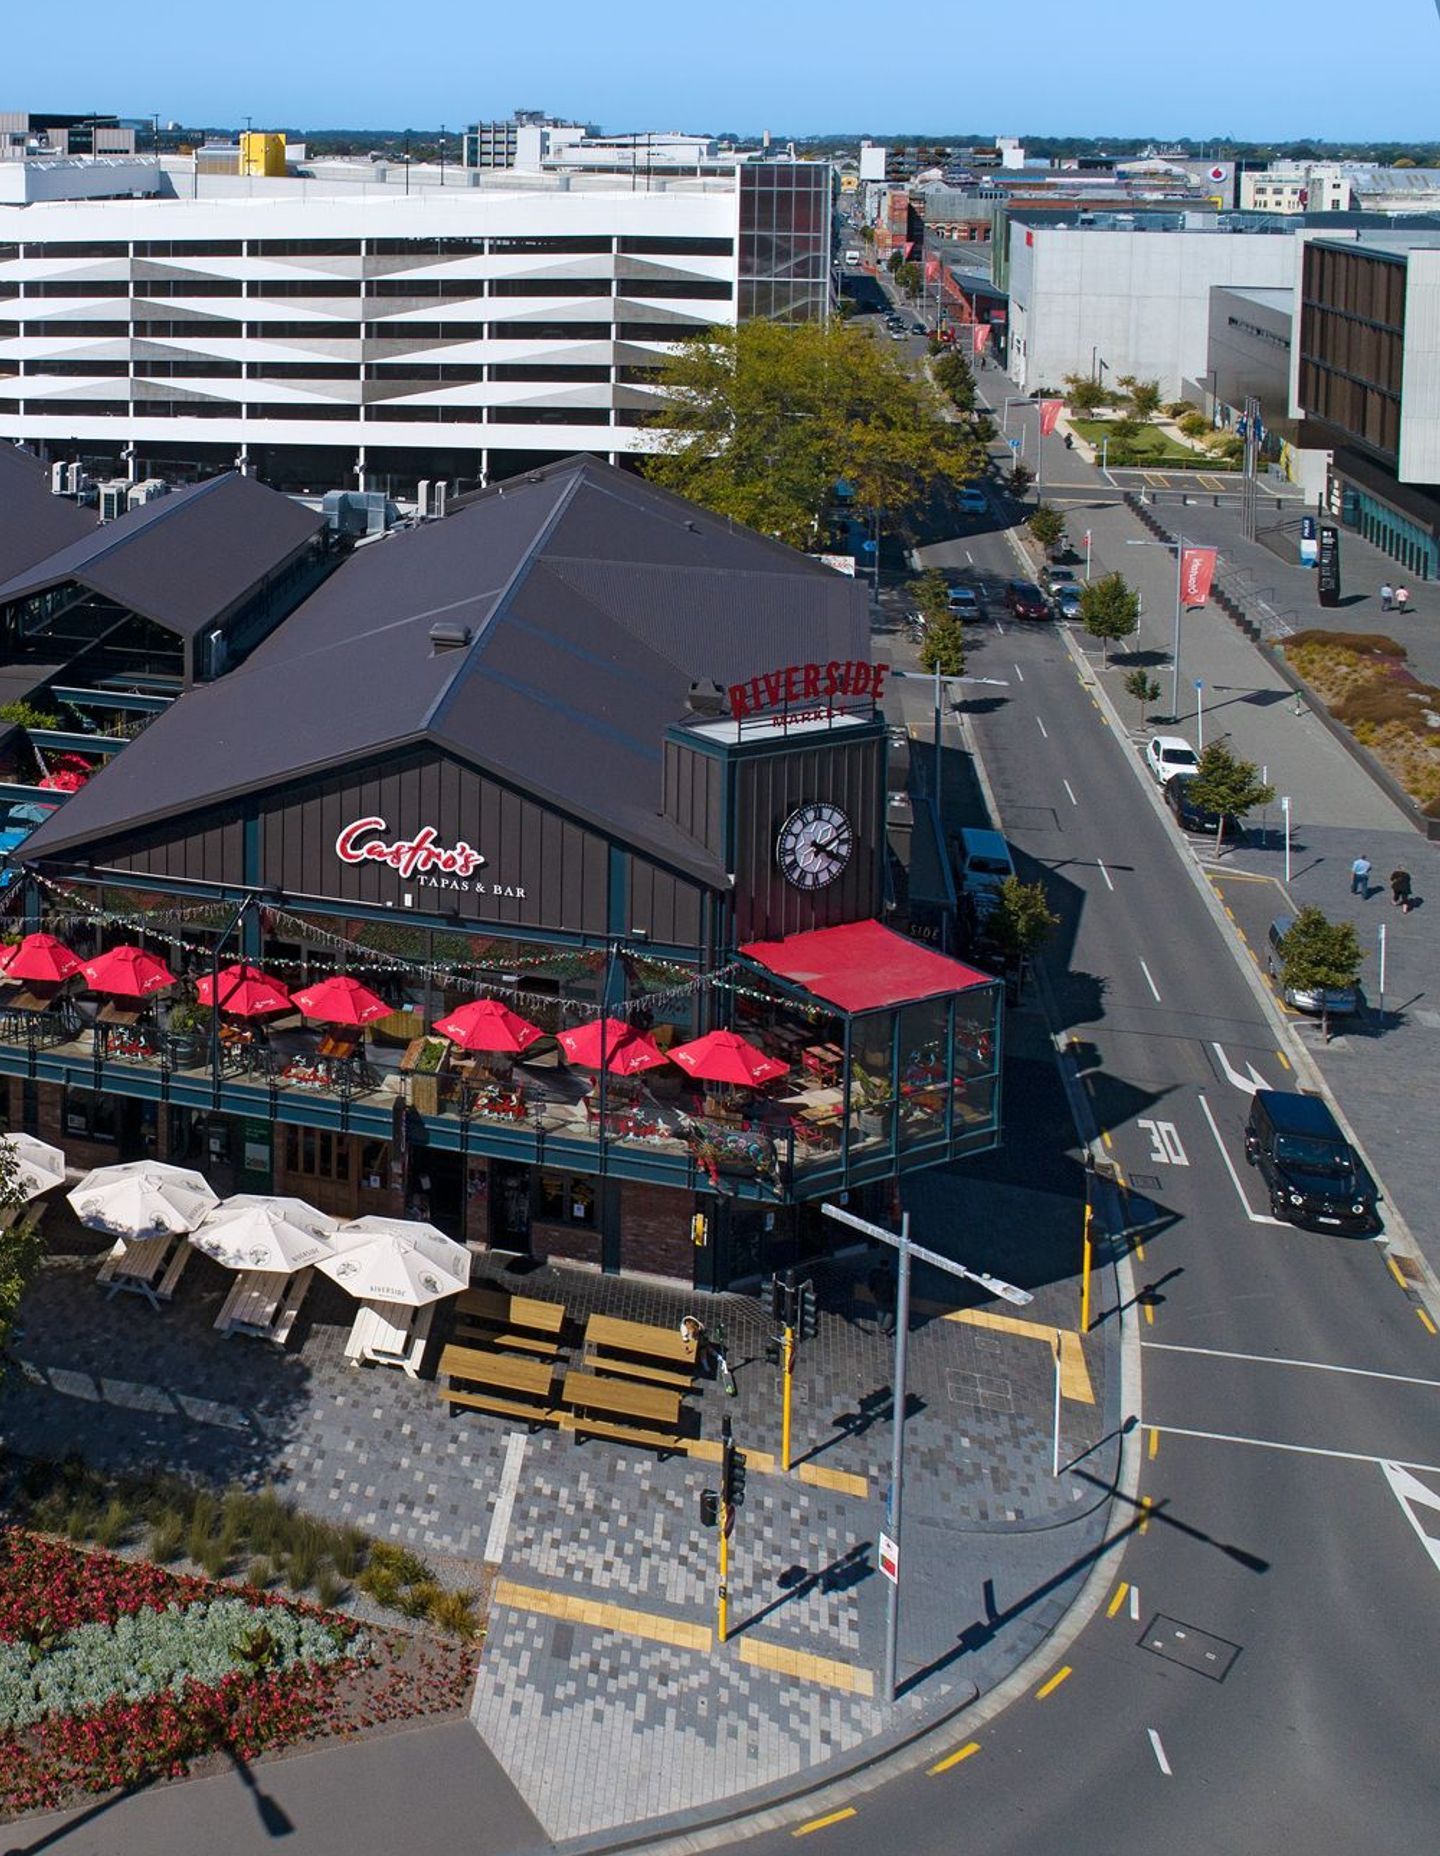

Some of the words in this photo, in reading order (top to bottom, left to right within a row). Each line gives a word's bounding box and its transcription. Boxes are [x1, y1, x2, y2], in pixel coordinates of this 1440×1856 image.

[728, 660, 890, 721] RIVERSIDE
[772, 706, 847, 727] MARKET
[336, 816, 485, 878] Castro's
[417, 874, 469, 892] TAPAS
[475, 882, 486, 893] &
[493, 884, 526, 898] BAR
[1137, 1119, 1190, 1167] 30
